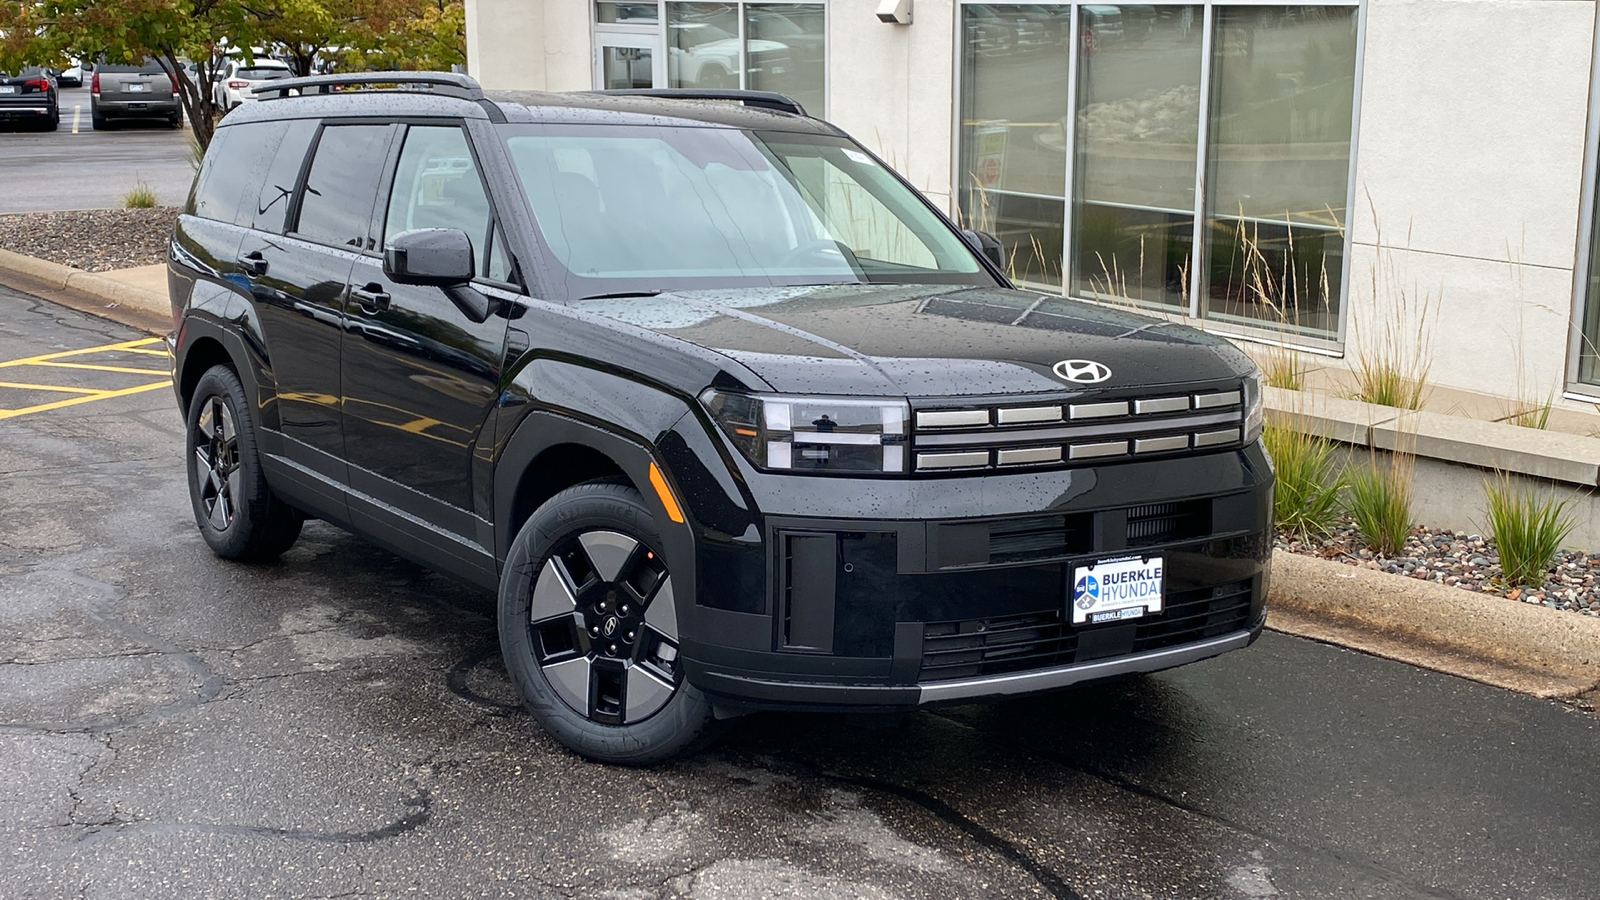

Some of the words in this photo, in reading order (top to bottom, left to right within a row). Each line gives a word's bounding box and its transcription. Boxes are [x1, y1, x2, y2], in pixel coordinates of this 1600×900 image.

[1103, 568, 1161, 585] BUERKLE
[1102, 580, 1162, 602] HYUNDAI
[1093, 611, 1121, 622] BUERKLE
